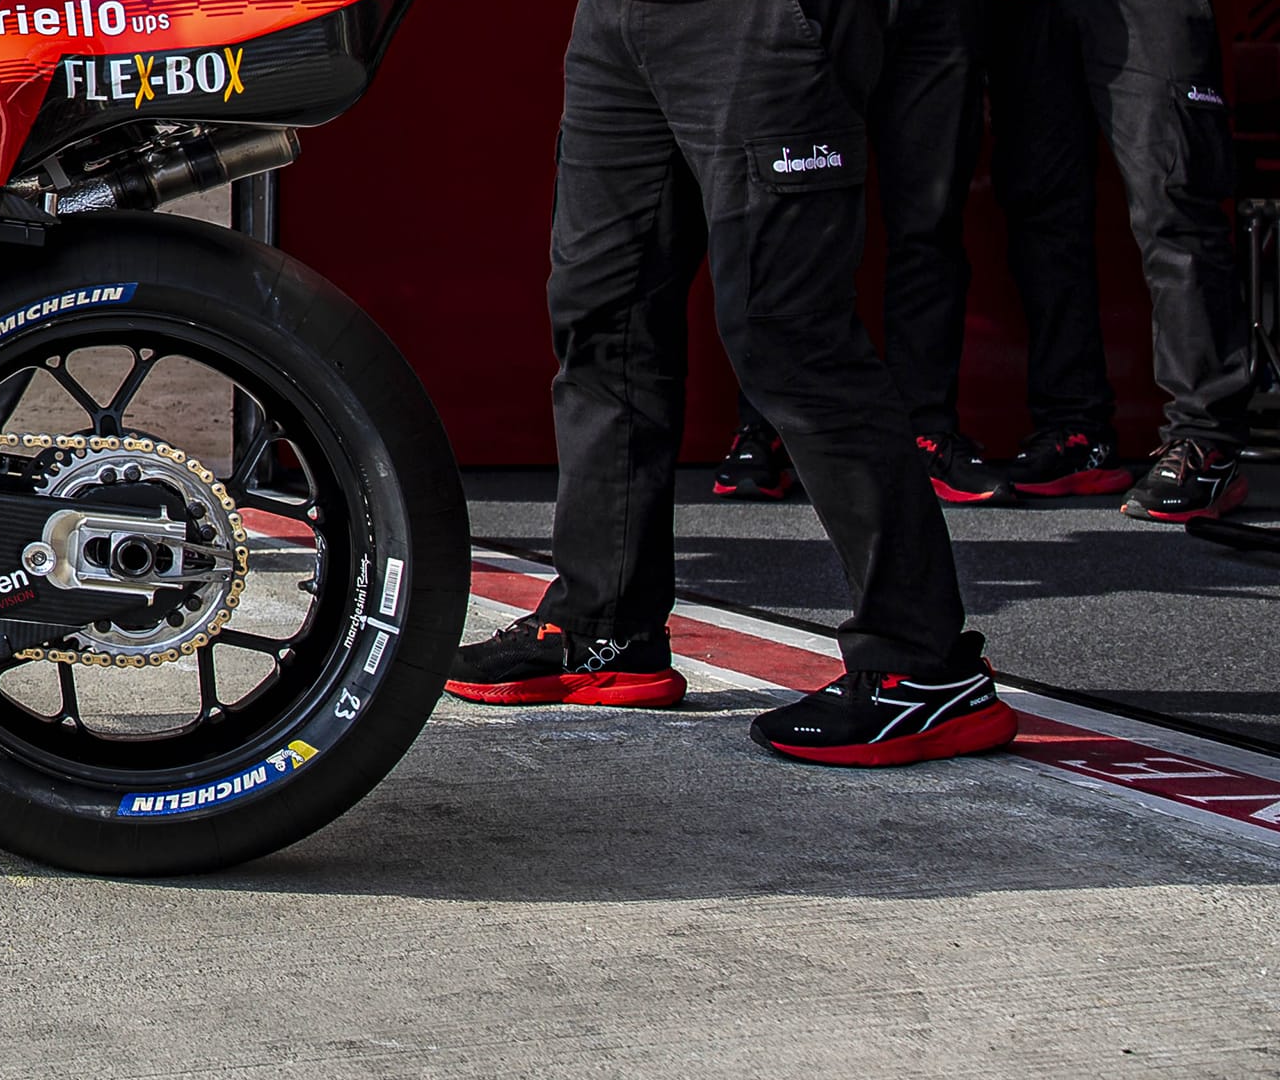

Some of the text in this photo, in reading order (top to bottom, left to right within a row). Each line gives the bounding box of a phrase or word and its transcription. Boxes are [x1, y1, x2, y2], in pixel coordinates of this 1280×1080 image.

[131, 9, 170, 34] ups
[63, 46, 246, 110] FLEX-BOX
[772, 144, 842, 174] diadora
[344, 588, 368, 650] marchesini
[131, 764, 269, 813] MICHELIN
